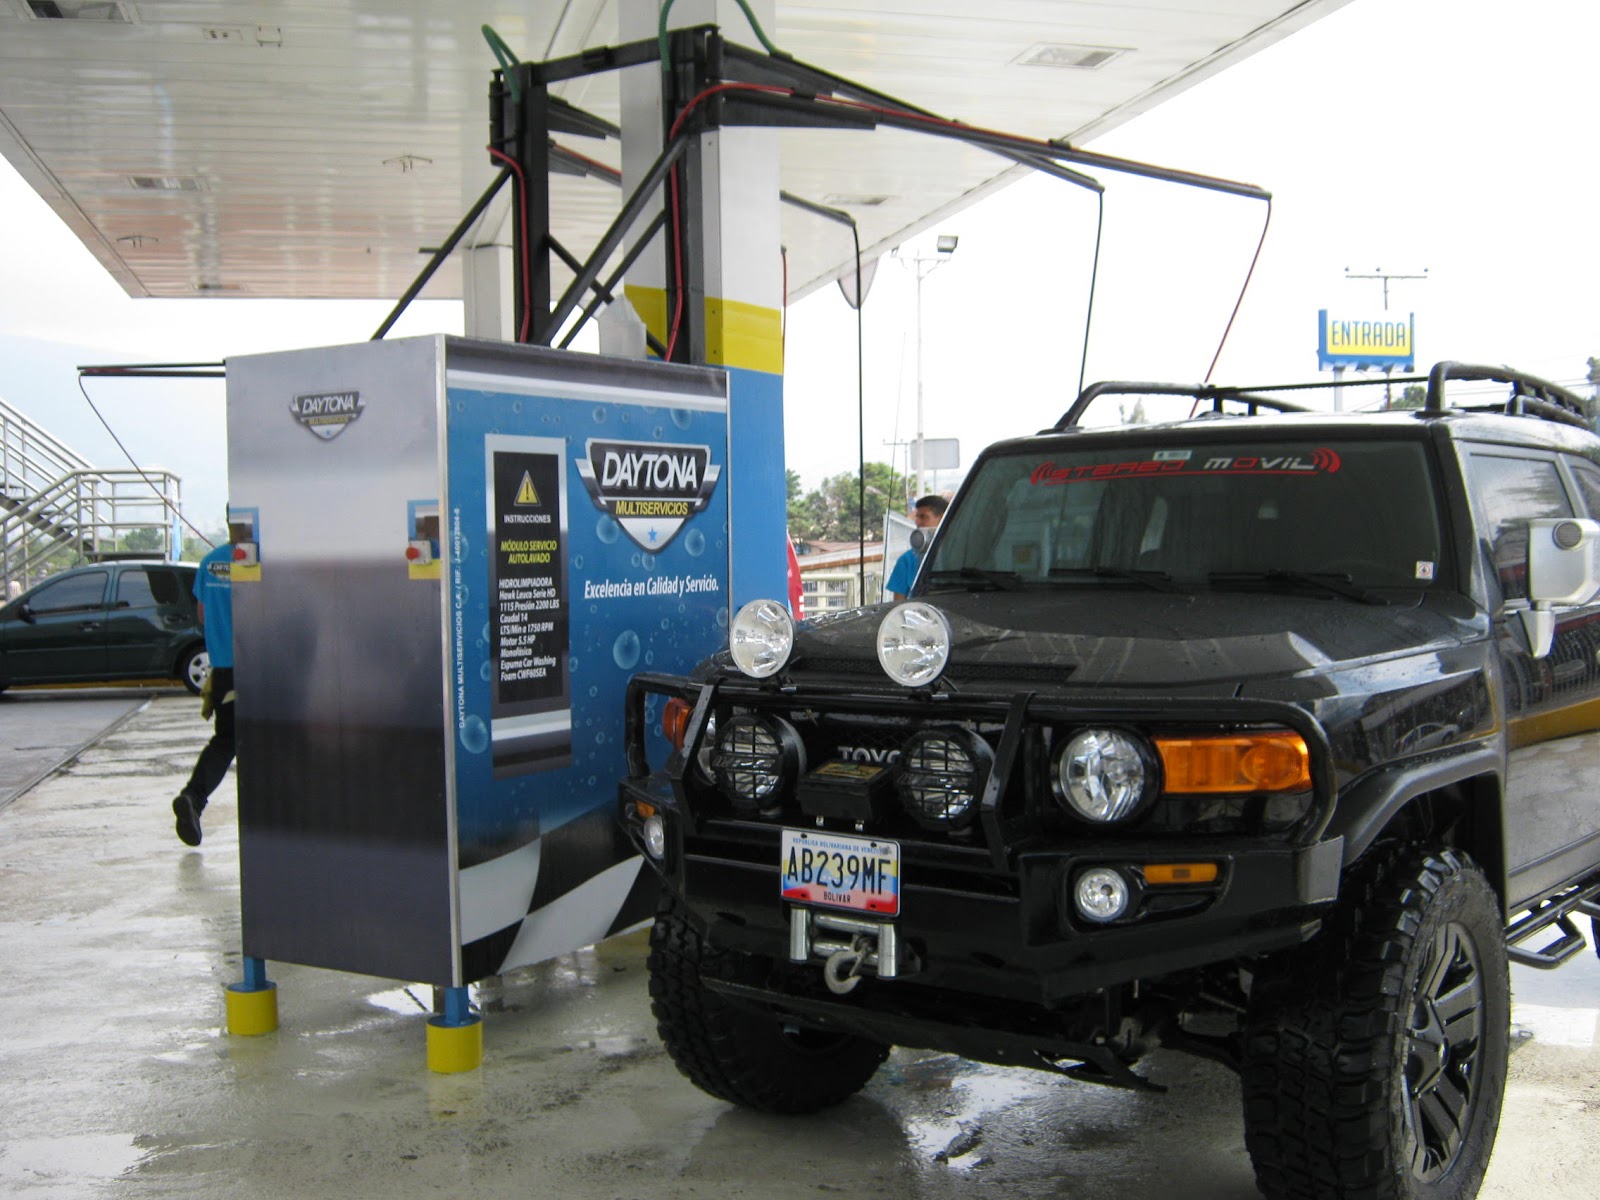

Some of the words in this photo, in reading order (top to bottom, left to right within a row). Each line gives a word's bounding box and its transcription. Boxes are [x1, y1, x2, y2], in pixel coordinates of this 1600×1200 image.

[1332, 320, 1406, 347] ENTRADA
[302, 395, 354, 414] DAYTONA
[602, 451, 698, 489] DAYTONA
[616, 501, 689, 515] MULTISERVICIOS
[503, 514, 551, 523] INSTRUCCIONES
[529, 540, 557, 551] SERVICIO
[508, 552, 551, 564] AUTOLAVADO
[499, 577, 553, 588] HIDROLIMPIADORA
[584, 578, 632, 599] Excelencia
[633, 581, 645, 595] en
[646, 576, 679, 595] Calidad
[678, 580, 685, 598] y
[685, 574, 719, 592] Servicio.
[533, 588, 547, 598] Serie
[547, 588, 556, 598] HD
[500, 602, 514, 612] 1115
[535, 600, 549, 610] 2200
[549, 599, 560, 609] LBS
[521, 612, 528, 622] 14
[527, 623, 541, 632] 1750
[541, 621, 554, 632] RPM
[456, 611, 464, 685] MULTISERVICIOS
[500, 637, 518, 647] Motor
[787, 846, 891, 895] AB239MF
